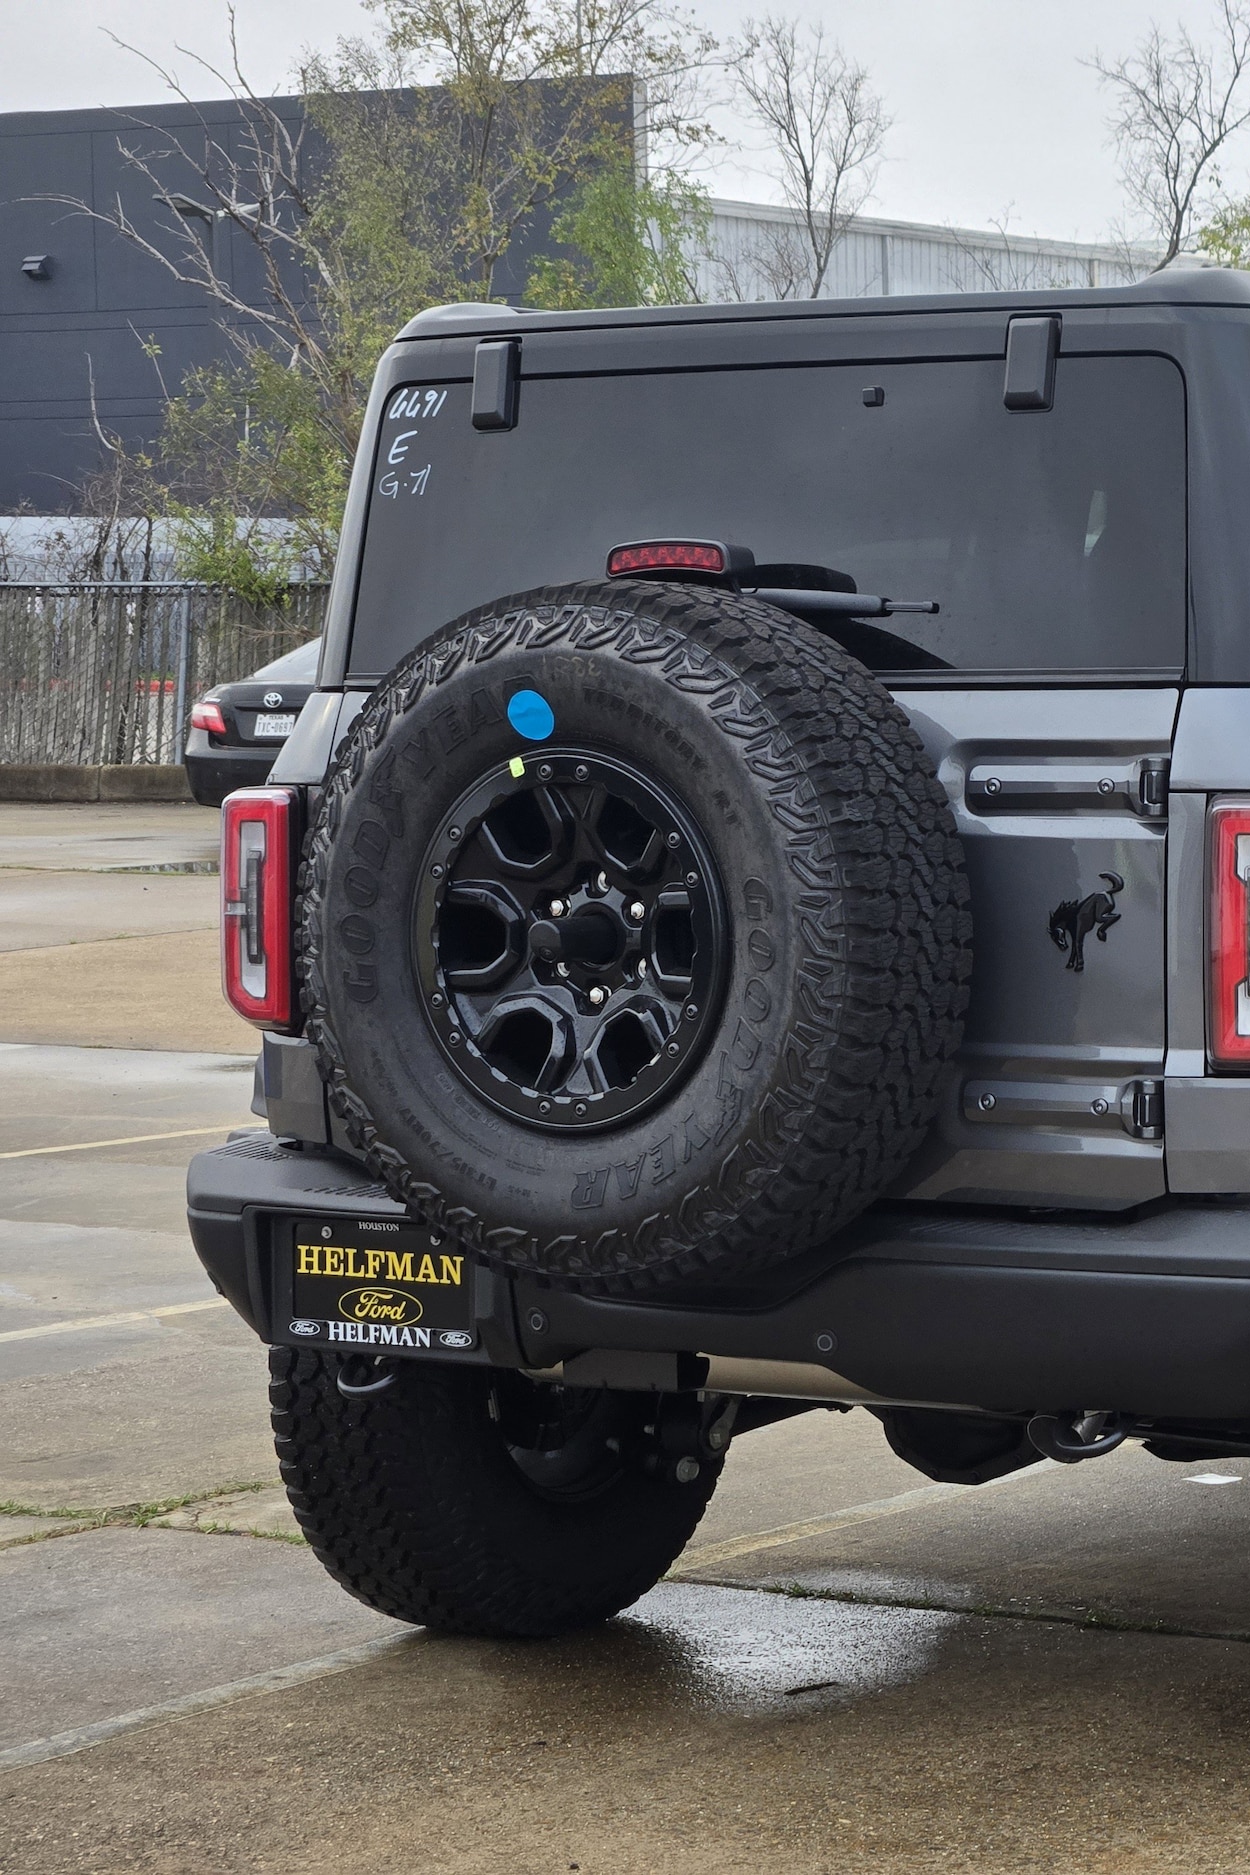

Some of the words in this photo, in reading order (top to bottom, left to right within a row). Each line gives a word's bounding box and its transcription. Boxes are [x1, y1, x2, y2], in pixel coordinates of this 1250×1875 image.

[387, 429, 418, 465] E
[571, 876, 775, 1210] GOODYEAR
[358, 1221, 400, 1232] HOUSTON
[297, 1245, 465, 1286] HELFMAN
[354, 1290, 407, 1321] Ford
[327, 1320, 433, 1348] HELFMAN
